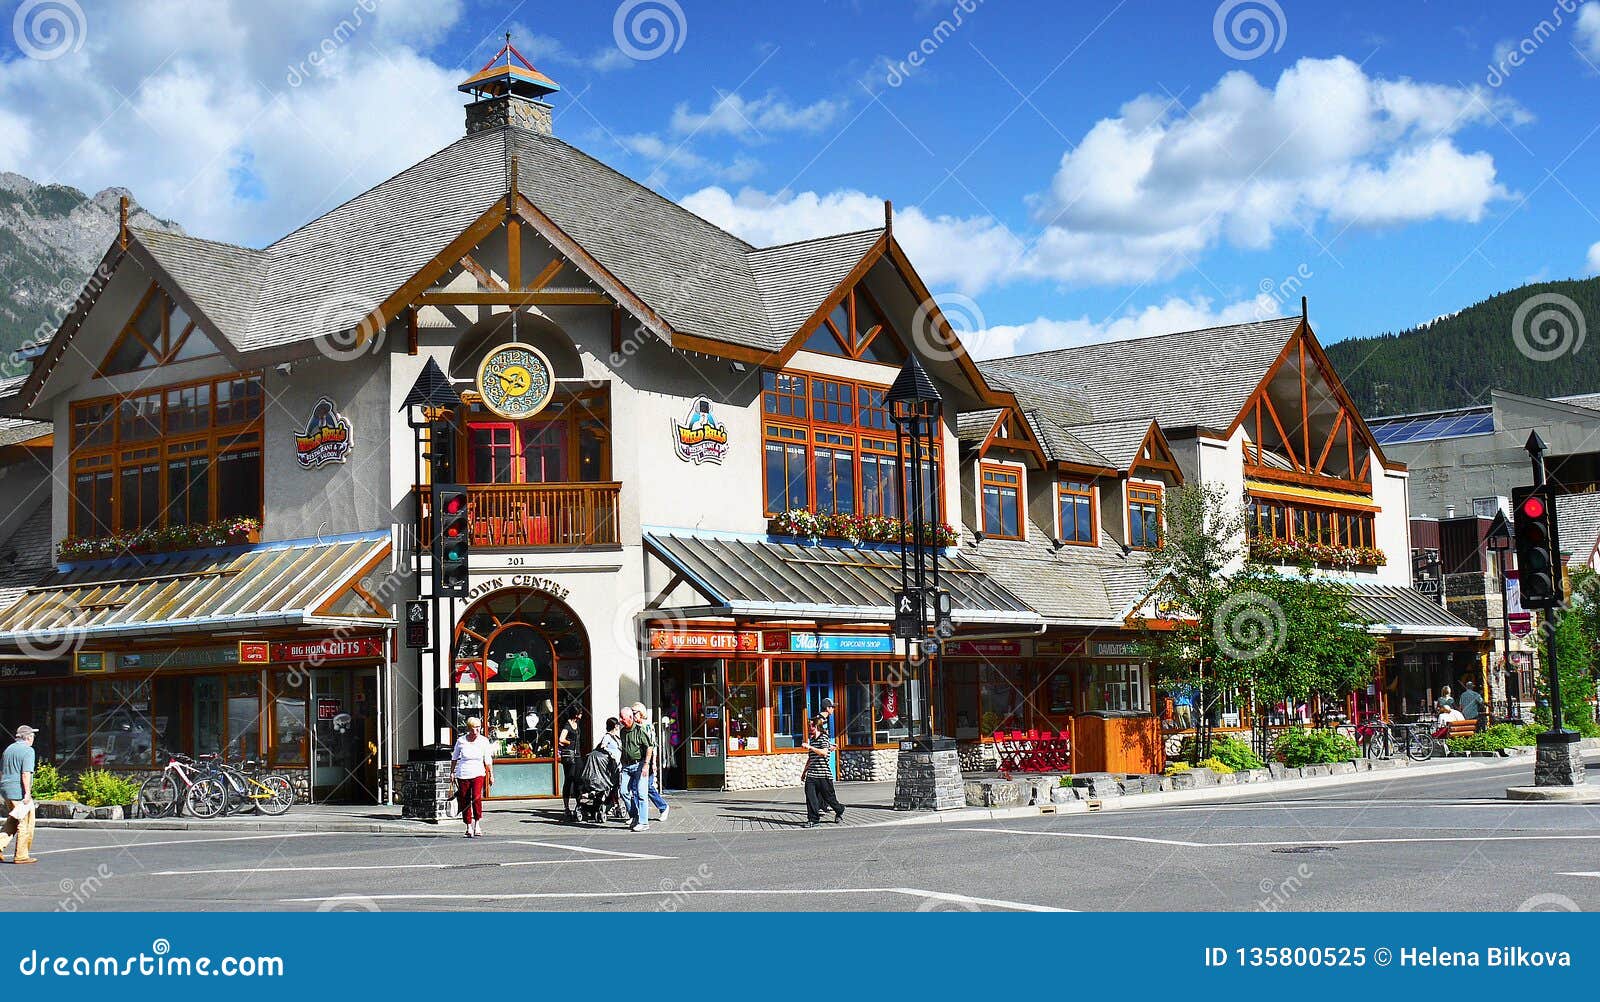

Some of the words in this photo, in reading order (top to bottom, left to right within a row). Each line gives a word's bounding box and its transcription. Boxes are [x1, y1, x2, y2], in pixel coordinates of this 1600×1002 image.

[507, 557, 525, 566] 201
[459, 576, 504, 606] TOWN
[511, 574, 570, 600] CENTRE
[291, 646, 304, 655] BIG
[305, 645, 327, 654] HORN
[329, 641, 360, 655] GIFTS
[672, 636, 685, 645] BIG
[687, 636, 708, 645] HORN
[709, 635, 738, 648] GIFTS
[795, 634, 830, 653] Mary's
[839, 640, 866, 648] POPCORN
[866, 640, 881, 648] SHOP
